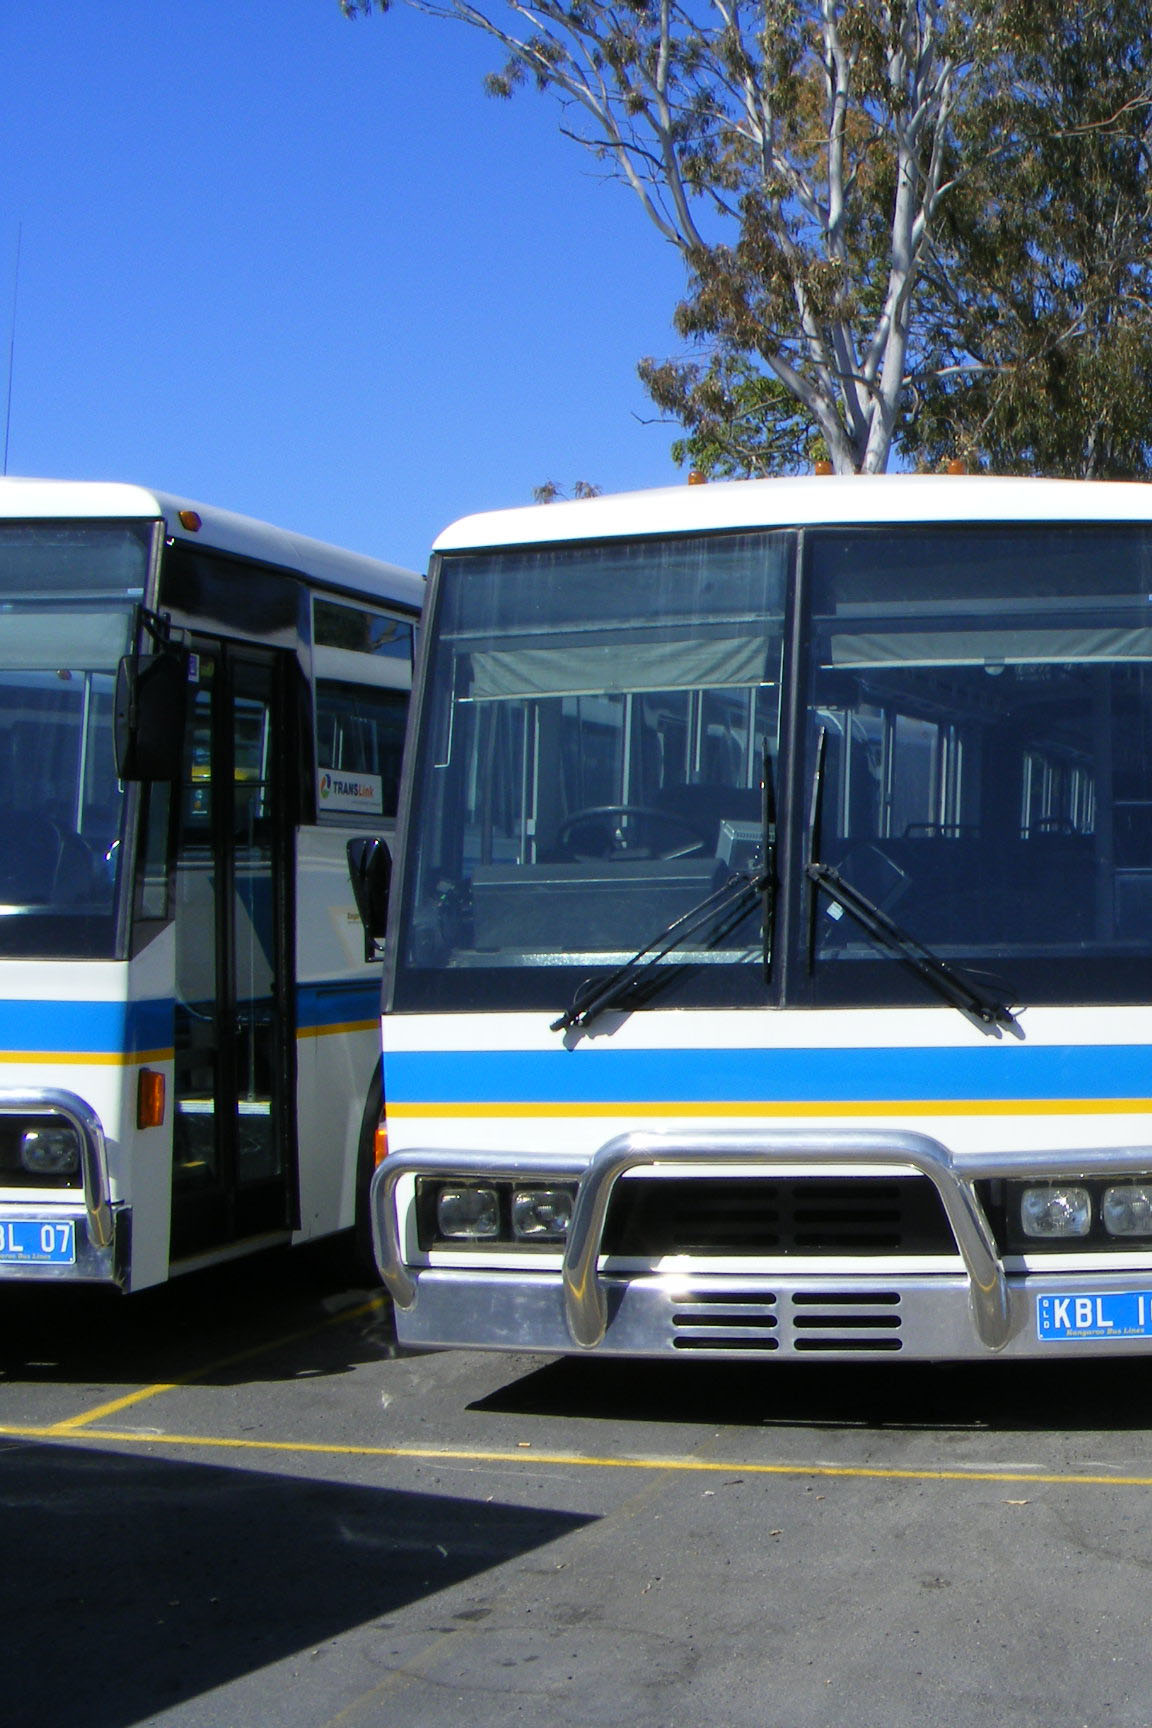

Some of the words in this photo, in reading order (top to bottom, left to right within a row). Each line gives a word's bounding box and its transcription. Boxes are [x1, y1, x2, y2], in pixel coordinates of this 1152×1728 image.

[333, 781, 375, 799] TRANSLink
[41, 1224, 70, 1253] 07
[1053, 1297, 1114, 1329] KBL
[1066, 1328, 1105, 1338] Kangaroo
[1106, 1327, 1121, 1336] Bus
[1123, 1326, 1145, 1335] Lines
